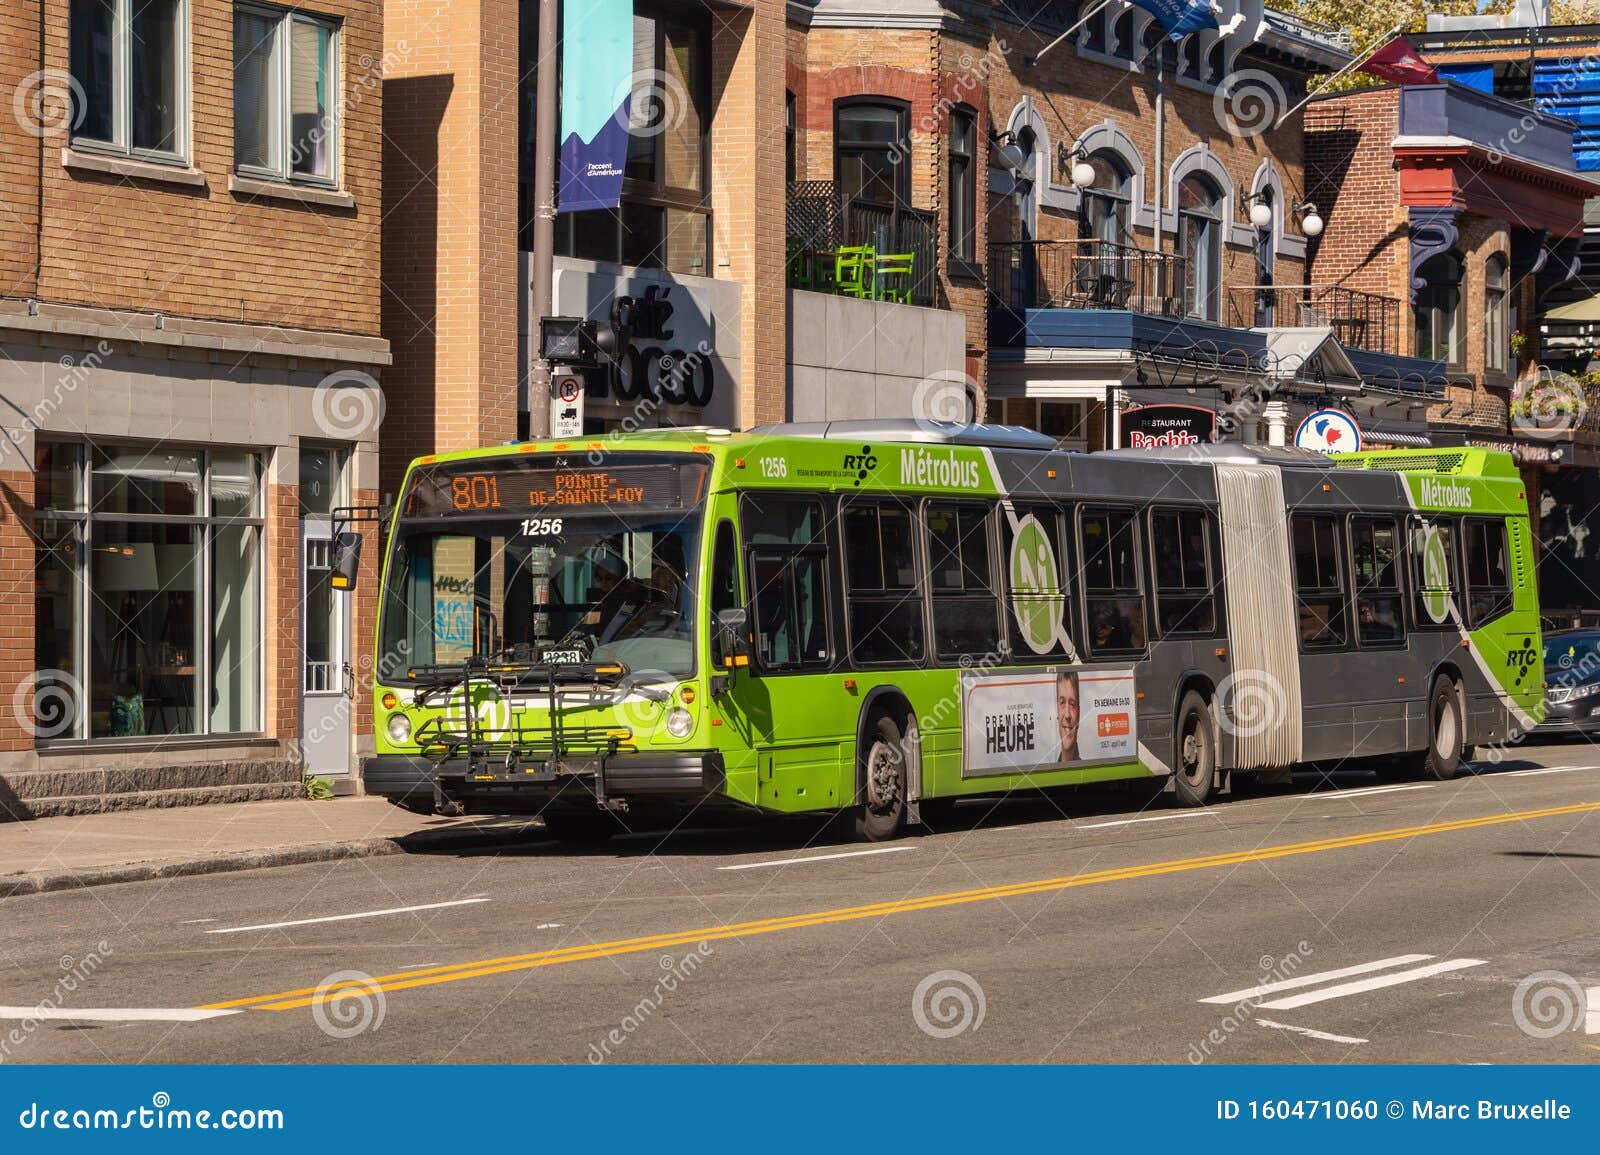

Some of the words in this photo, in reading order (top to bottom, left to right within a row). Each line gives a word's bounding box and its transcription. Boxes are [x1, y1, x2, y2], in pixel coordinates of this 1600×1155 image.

[1140, 419, 1192, 428] RESTAURANT
[760, 457, 787, 478] 1256
[843, 455, 878, 471] RTC
[900, 447, 980, 488] Métrobus
[452, 475, 502, 510] 801
[555, 473, 617, 490] POINTE-
[529, 487, 645, 506] DE-SAINTE-FOY
[1420, 476, 1472, 508] Métrobus
[520, 518, 563, 536] 1256
[1506, 649, 1537, 667] RTC
[985, 711, 1034, 728] PREMIÈRE
[986, 721, 1035, 754] HEURE
